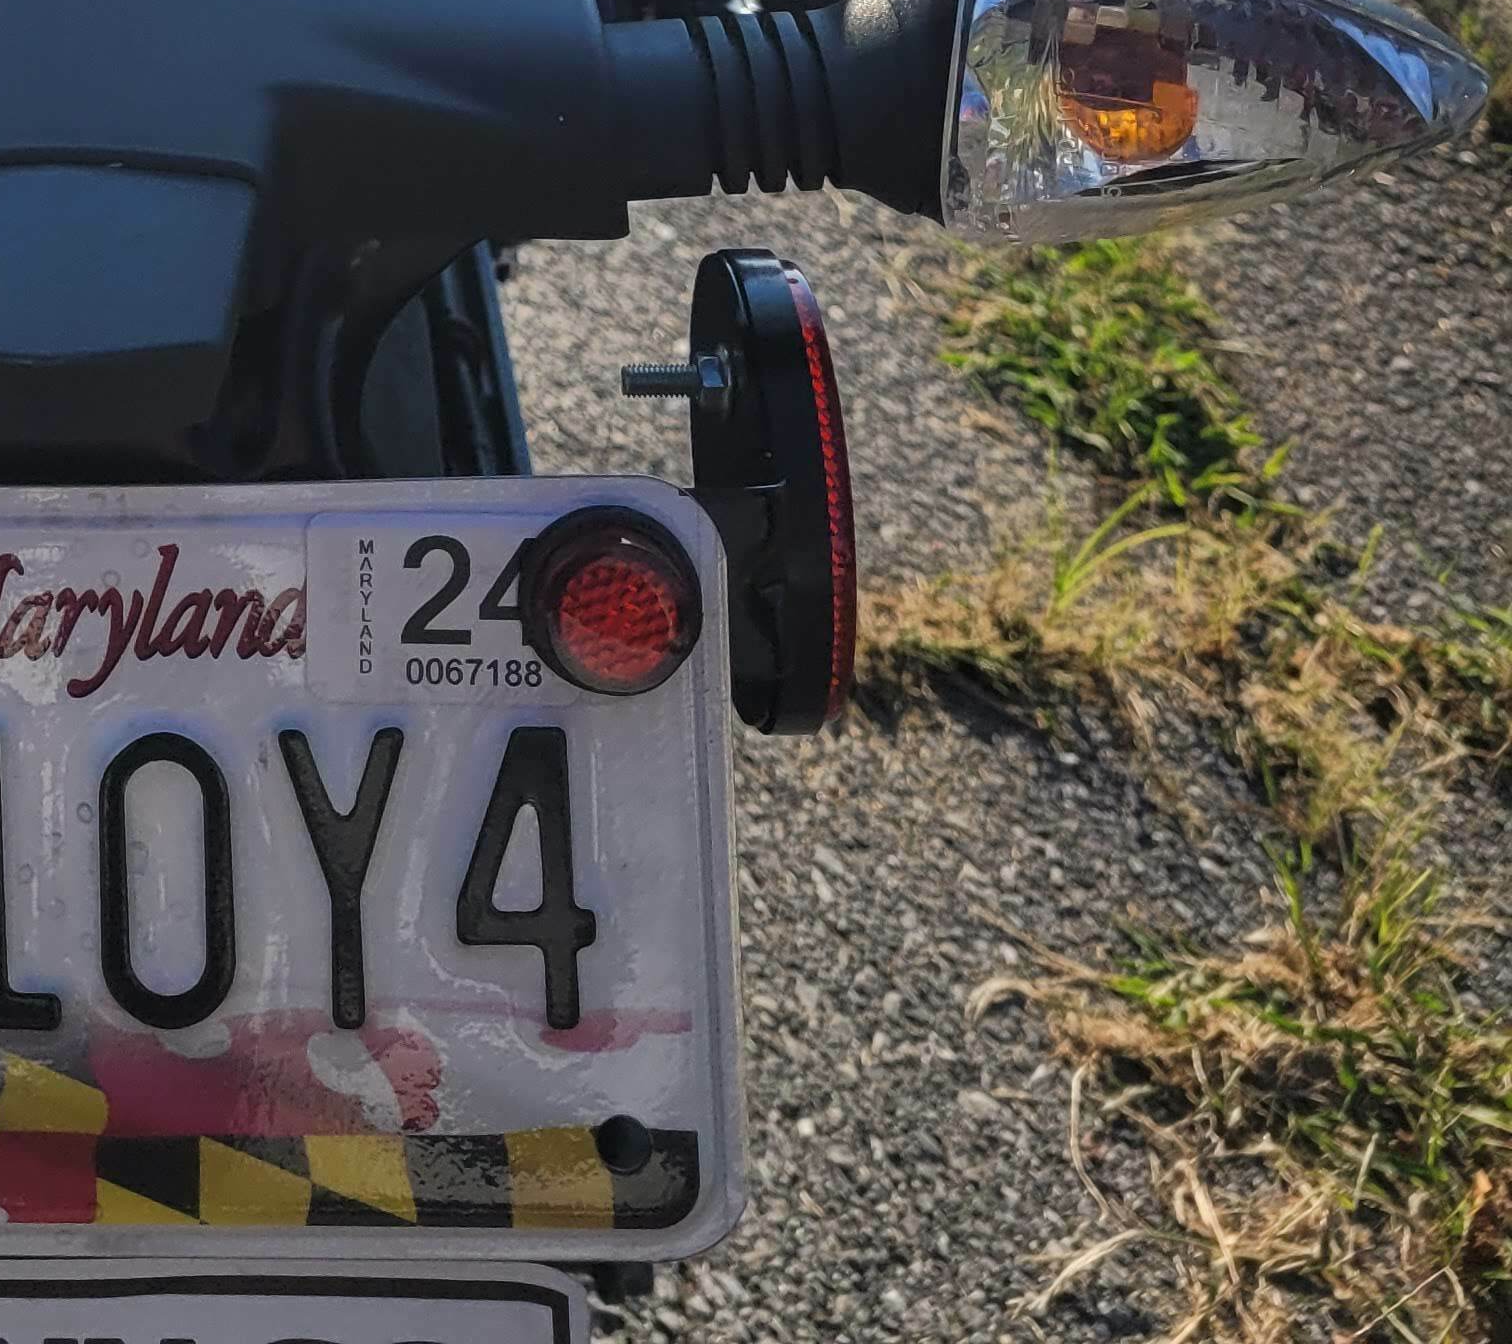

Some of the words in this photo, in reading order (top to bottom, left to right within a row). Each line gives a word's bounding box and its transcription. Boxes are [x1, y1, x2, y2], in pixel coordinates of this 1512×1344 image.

[358, 538, 375, 675] MARYLAND
[399, 534, 538, 647] 24
[405, 657, 543, 688] 0067188
